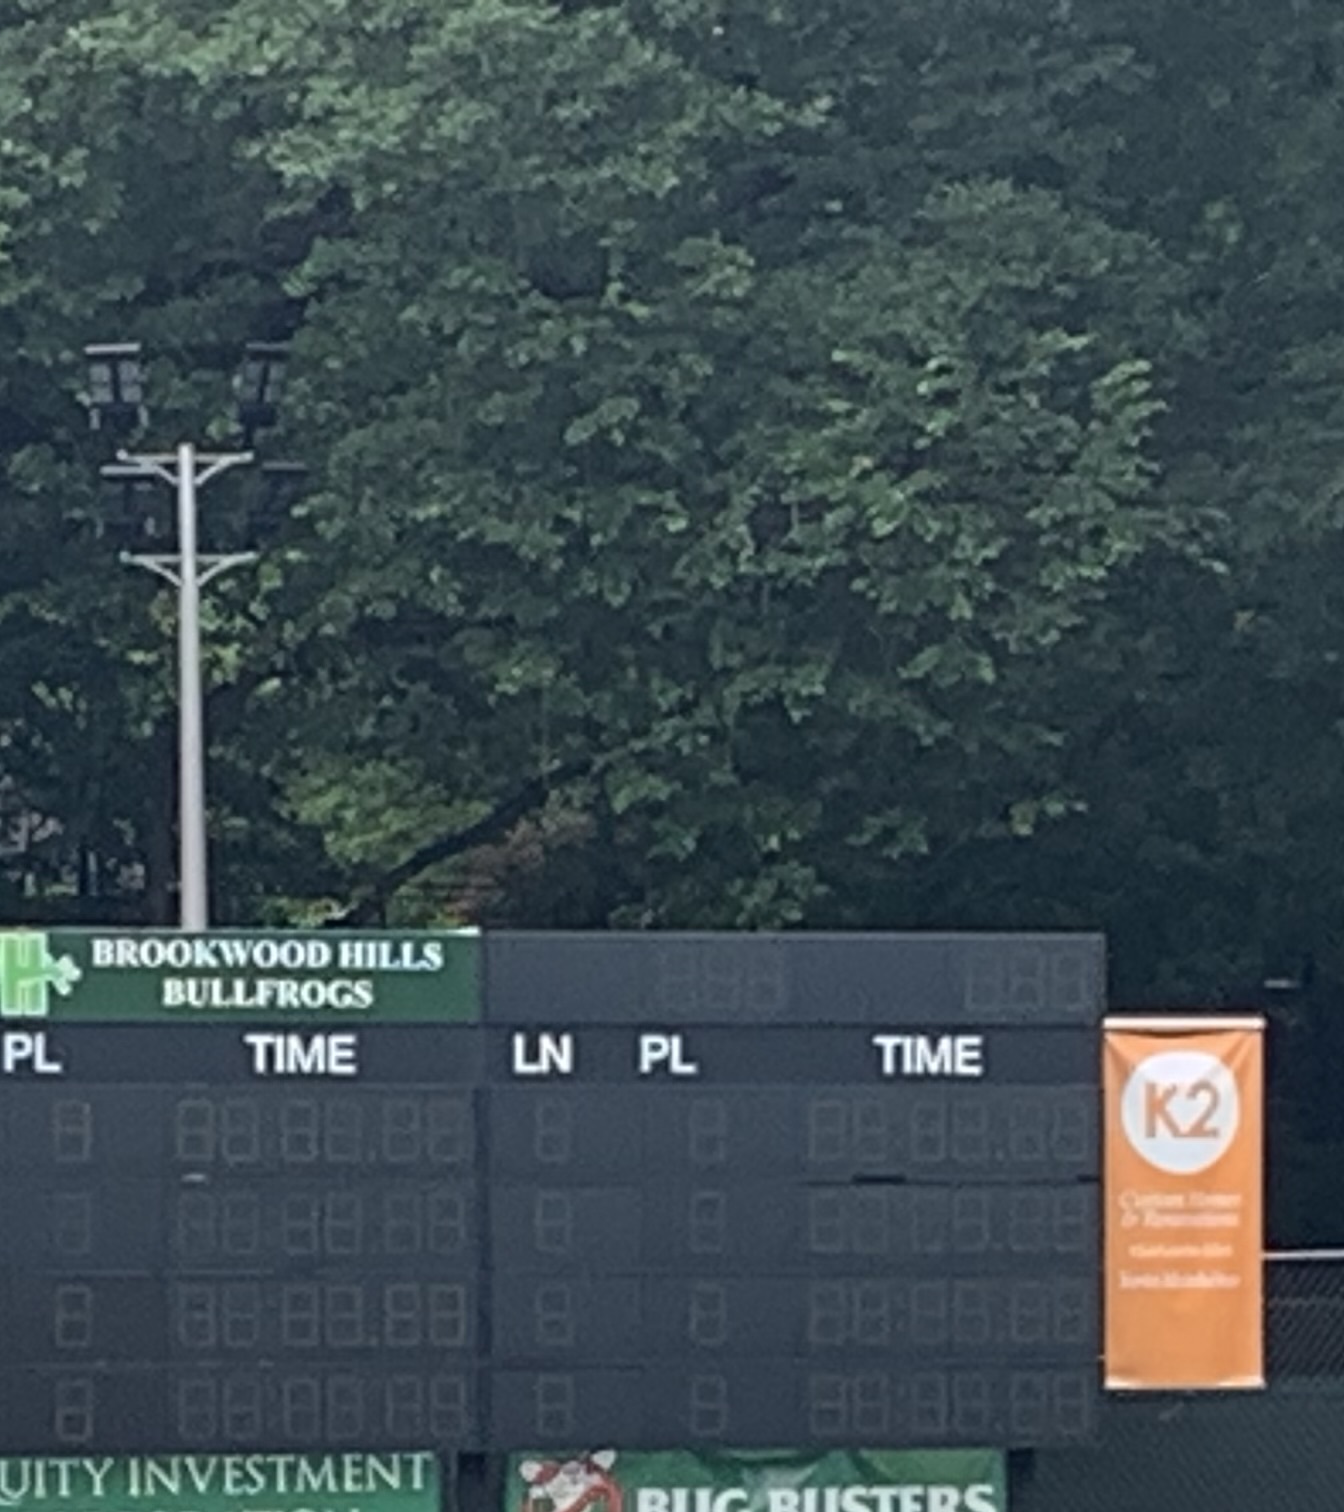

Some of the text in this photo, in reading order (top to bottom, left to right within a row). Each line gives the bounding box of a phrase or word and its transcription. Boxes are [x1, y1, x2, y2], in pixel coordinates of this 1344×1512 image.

[91, 939, 443, 970] BROOKWOOD HILLS
[163, 978, 374, 1009] BULLFROGS
[2, 1032, 62, 1072] PL
[244, 1033, 358, 1073] TIME
[513, 1033, 983, 1076] LN PL TIME
[1144, 1082, 1221, 1138] K2
[129, 1452, 435, 1498] INVESTMENT
